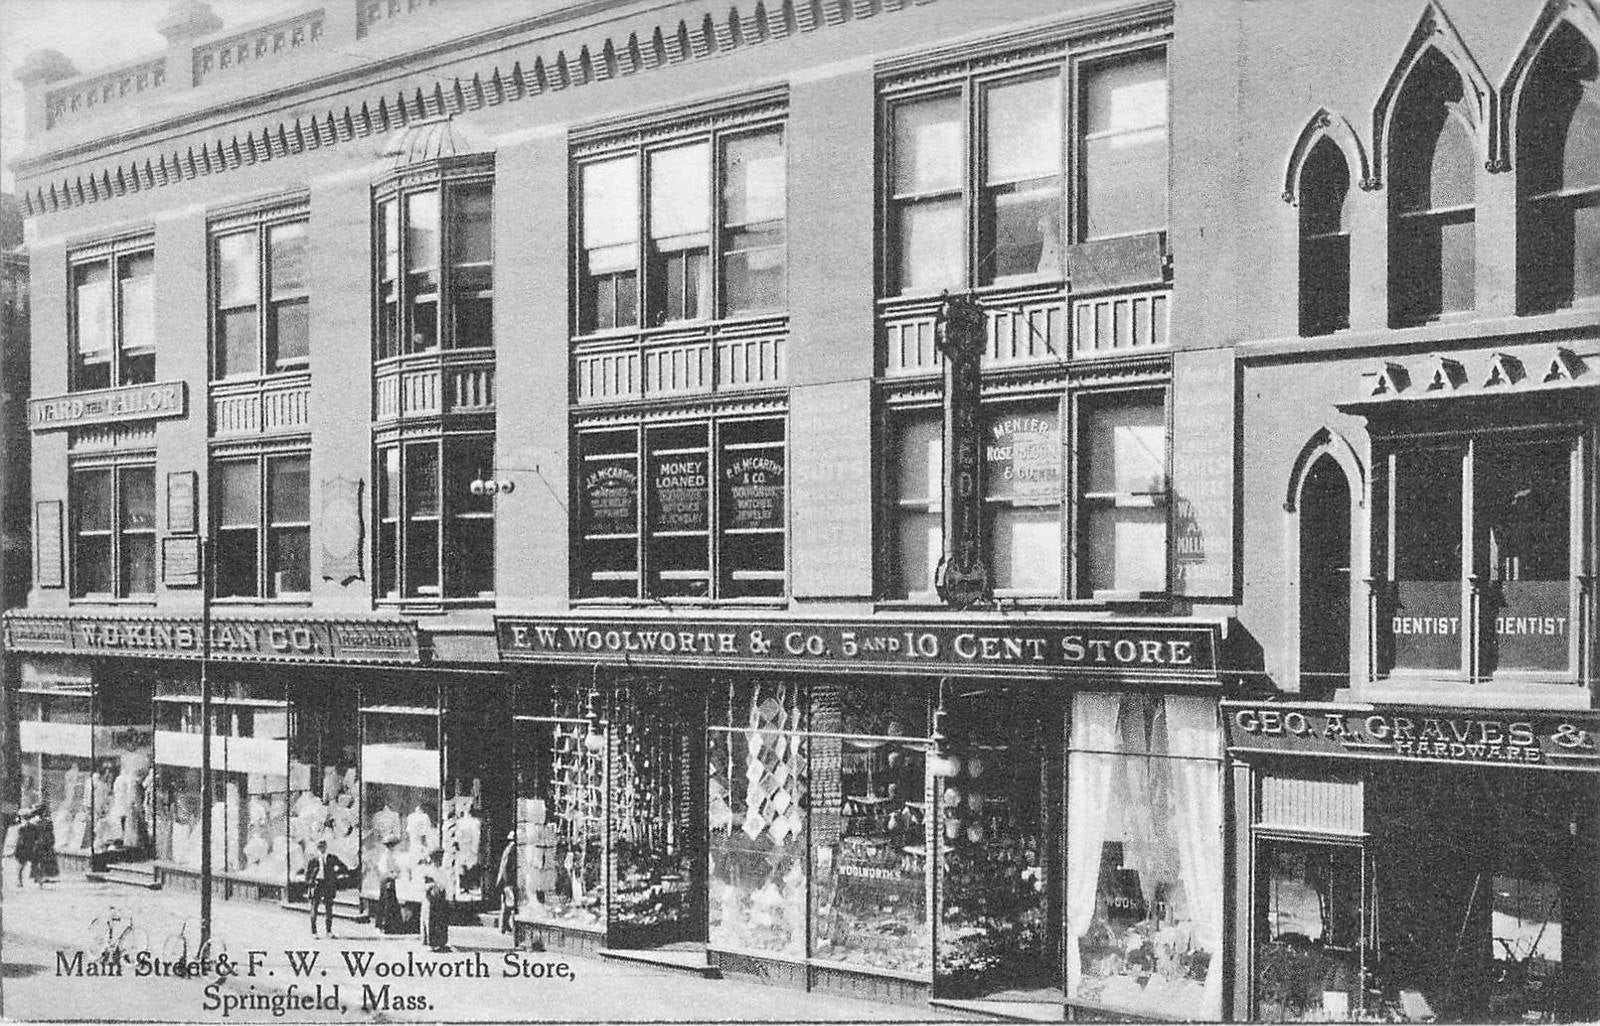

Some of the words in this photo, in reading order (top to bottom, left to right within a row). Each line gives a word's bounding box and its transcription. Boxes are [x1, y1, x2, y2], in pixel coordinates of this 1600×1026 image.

[32, 399, 84, 423] WARD
[104, 387, 178, 415] TAILOR
[660, 461, 702, 475] MONEY
[655, 475, 705, 489] LOANED
[1392, 617, 1459, 635] DENTIST
[1495, 617, 1566, 635] DENTIST
[269, 627, 321, 651] CO.
[565, 627, 739, 654] WOOLWORTH
[750, 630, 771, 655] &
[785, 632, 832, 657] CO.
[841, 633, 858, 657] 5
[904, 632, 938, 657] 10
[954, 633, 1048, 660] CENT
[1060, 635, 1193, 665] STORE
[1235, 709, 1313, 736] GEO.
[1365, 715, 1535, 747] GRAVES
[1550, 724, 1593, 748] &
[1396, 739, 1541, 763] HARDWARE
